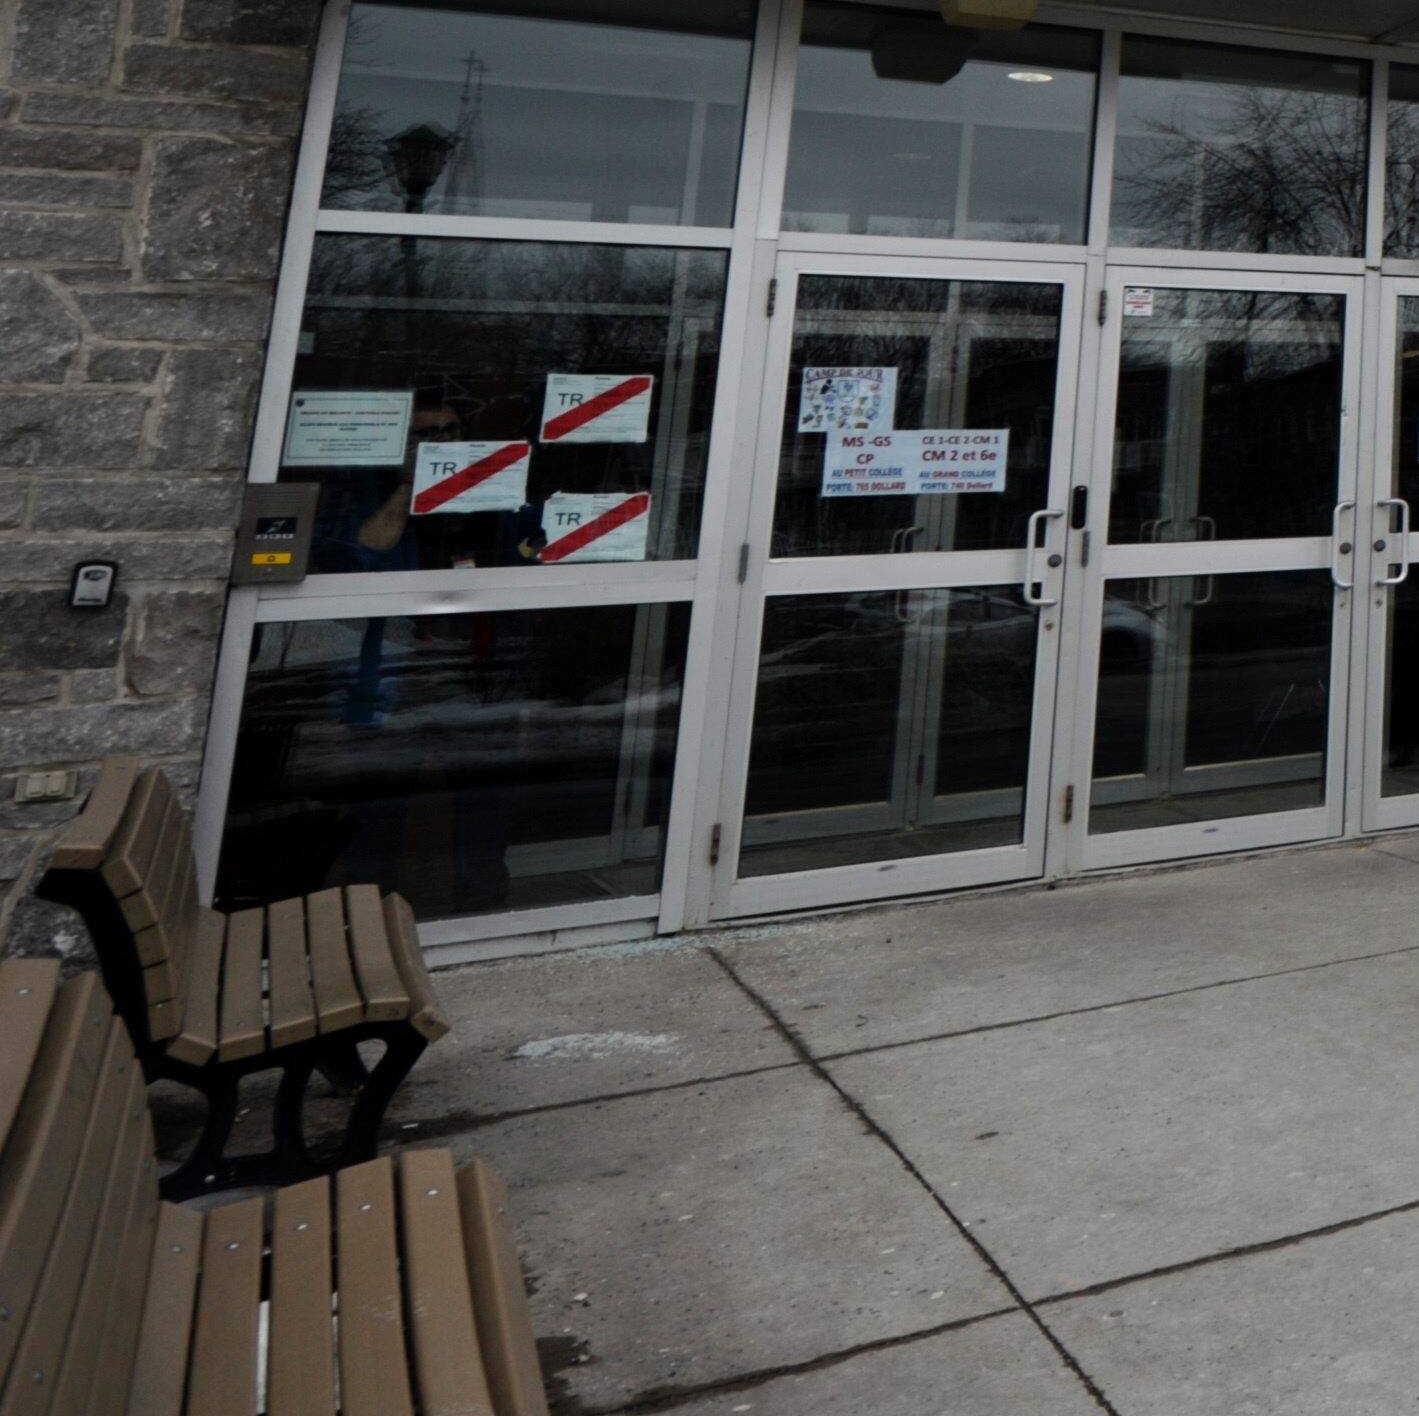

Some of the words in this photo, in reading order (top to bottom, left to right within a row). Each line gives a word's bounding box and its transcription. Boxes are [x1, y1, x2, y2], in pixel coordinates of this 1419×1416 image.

[805, 368, 837, 380] CAMP
[557, 392, 584, 406] TR
[842, 435, 865, 448] MS
[922, 436, 935, 445] CE
[856, 453, 875, 465] CP
[922, 450, 946, 462] CM
[949, 450, 959, 461] 2
[962, 451, 977, 461] et
[980, 450, 997, 461] 6e
[429, 461, 458, 477] TR
[831, 468, 844, 477] AU
[844, 468, 867, 477] PETIT
[919, 470, 931, 478] AU
[931, 470, 960, 478] GRAND
[871, 481, 907, 490] DOLLARD
[554, 511, 582, 527] TR
